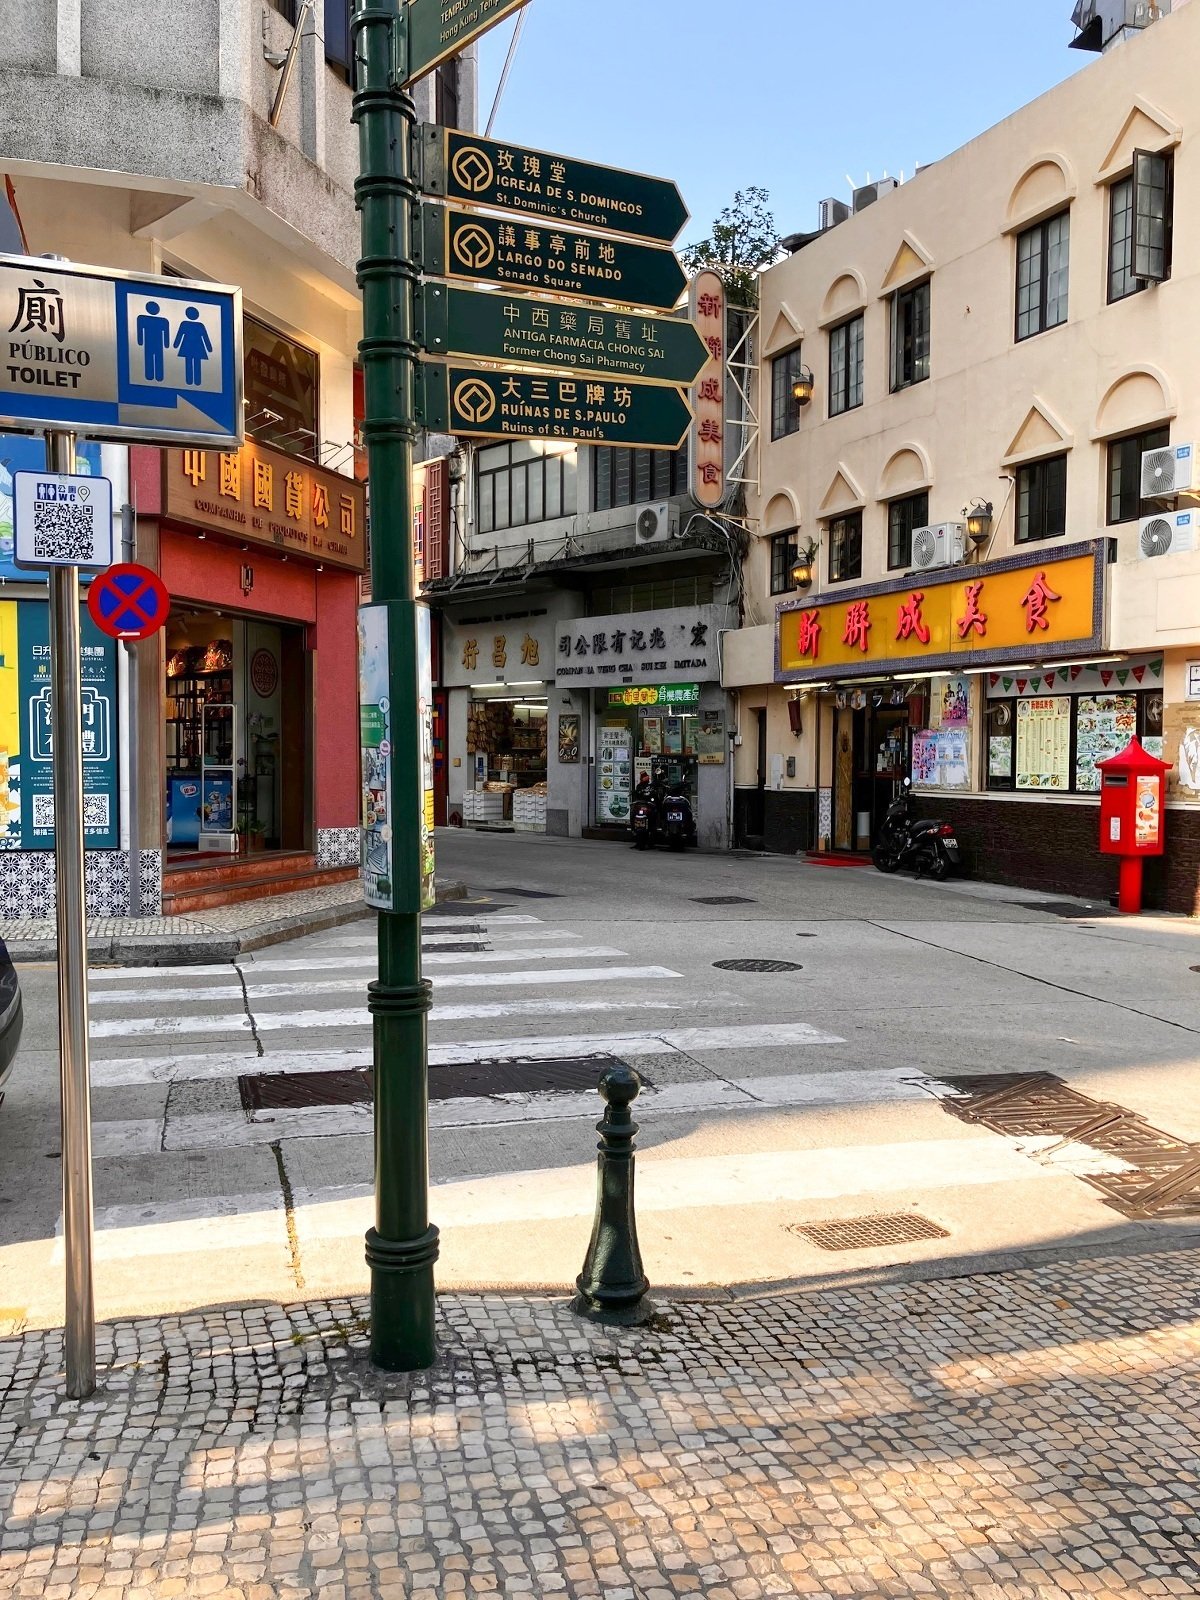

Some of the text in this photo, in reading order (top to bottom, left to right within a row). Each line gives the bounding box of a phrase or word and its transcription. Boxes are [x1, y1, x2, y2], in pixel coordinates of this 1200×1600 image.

[440, 23, 458, 43] Hong
[460, 10, 478, 28] Kung
[497, 149, 566, 185] 玫瑰堂
[496, 192, 607, 224] St. Dominic's Church
[497, 175, 643, 216] IGREJA DE S. DOMINGOS
[498, 223, 615, 264] 議事亭前地
[497, 266, 582, 290] Senado Square
[498, 250, 622, 281] LARGO DO SENADO
[8, 278, 66, 344] 廁
[503, 303, 658, 343] 中西藥局舊址
[8, 339, 90, 367] PÚBLICO
[503, 343, 645, 372] Former Chong Sai Pharmacy
[504, 328, 664, 359] ANTIGA FARMÁCIA CHONG SAI
[7, 365, 82, 389] TOILET
[502, 376, 632, 407] 大三巴牌坊
[501, 400, 626, 424] RUÍNAS DE S.PAULO
[502, 421, 604, 438] Ruins of St. Paul's
[183, 450, 355, 538] 中國國貨公司
[195, 500, 246, 524] COMPANHIA
[797, 571, 1062, 658] 新聯成美食
